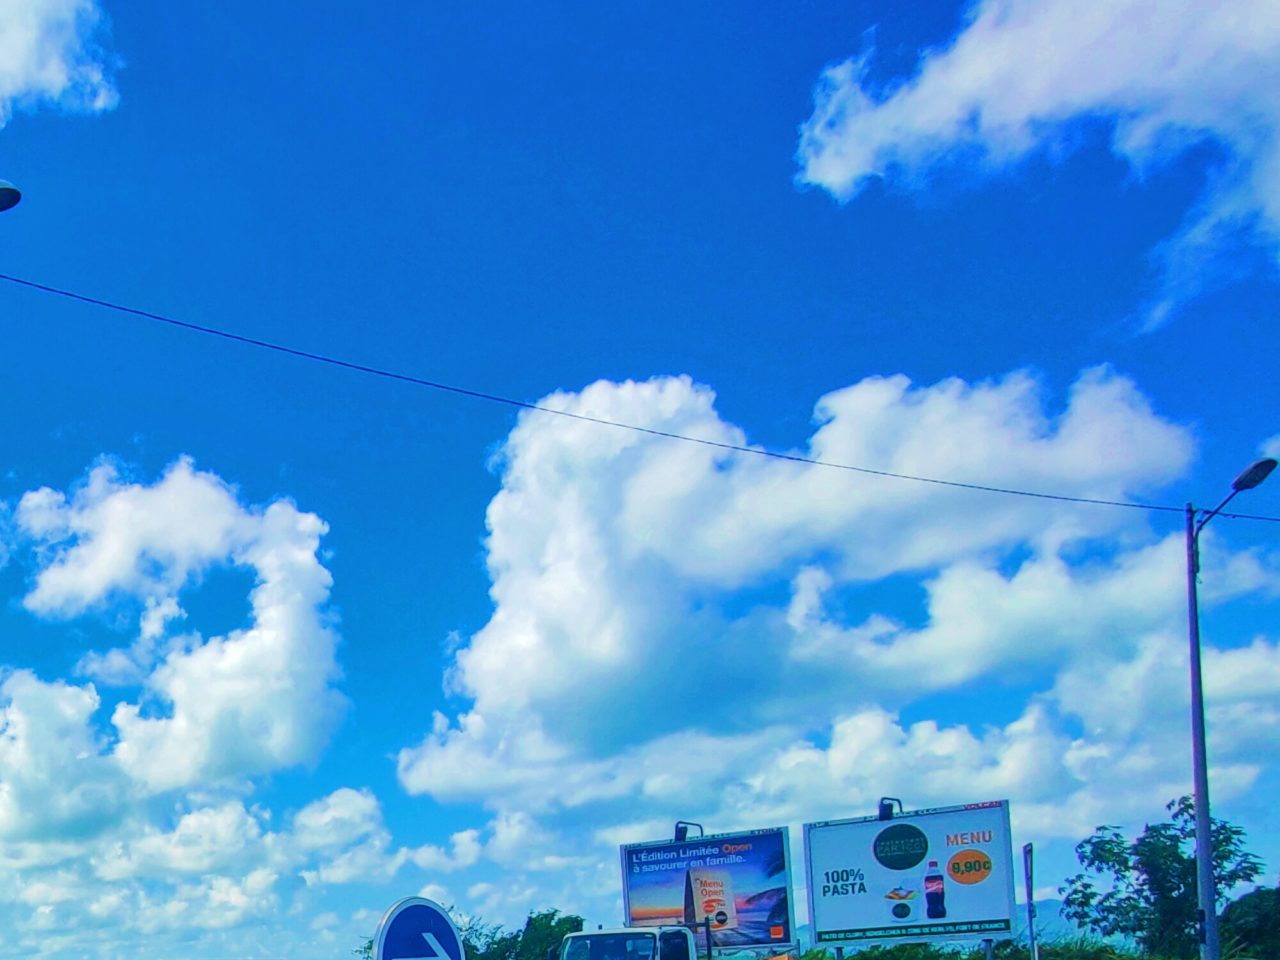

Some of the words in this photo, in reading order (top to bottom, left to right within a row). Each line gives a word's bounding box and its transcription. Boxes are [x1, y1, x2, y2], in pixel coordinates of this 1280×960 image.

[946, 830, 993, 847] MENU
[633, 851, 677, 862] L'Édition
[681, 847, 719, 857] Limitée
[722, 843, 752, 854] Open
[633, 862, 640, 873] à
[642, 861, 687, 872] savourer
[690, 859, 704, 868] en
[706, 855, 746, 866] famille.
[823, 868, 865, 885] 100%
[822, 882, 867, 897] PASTA
